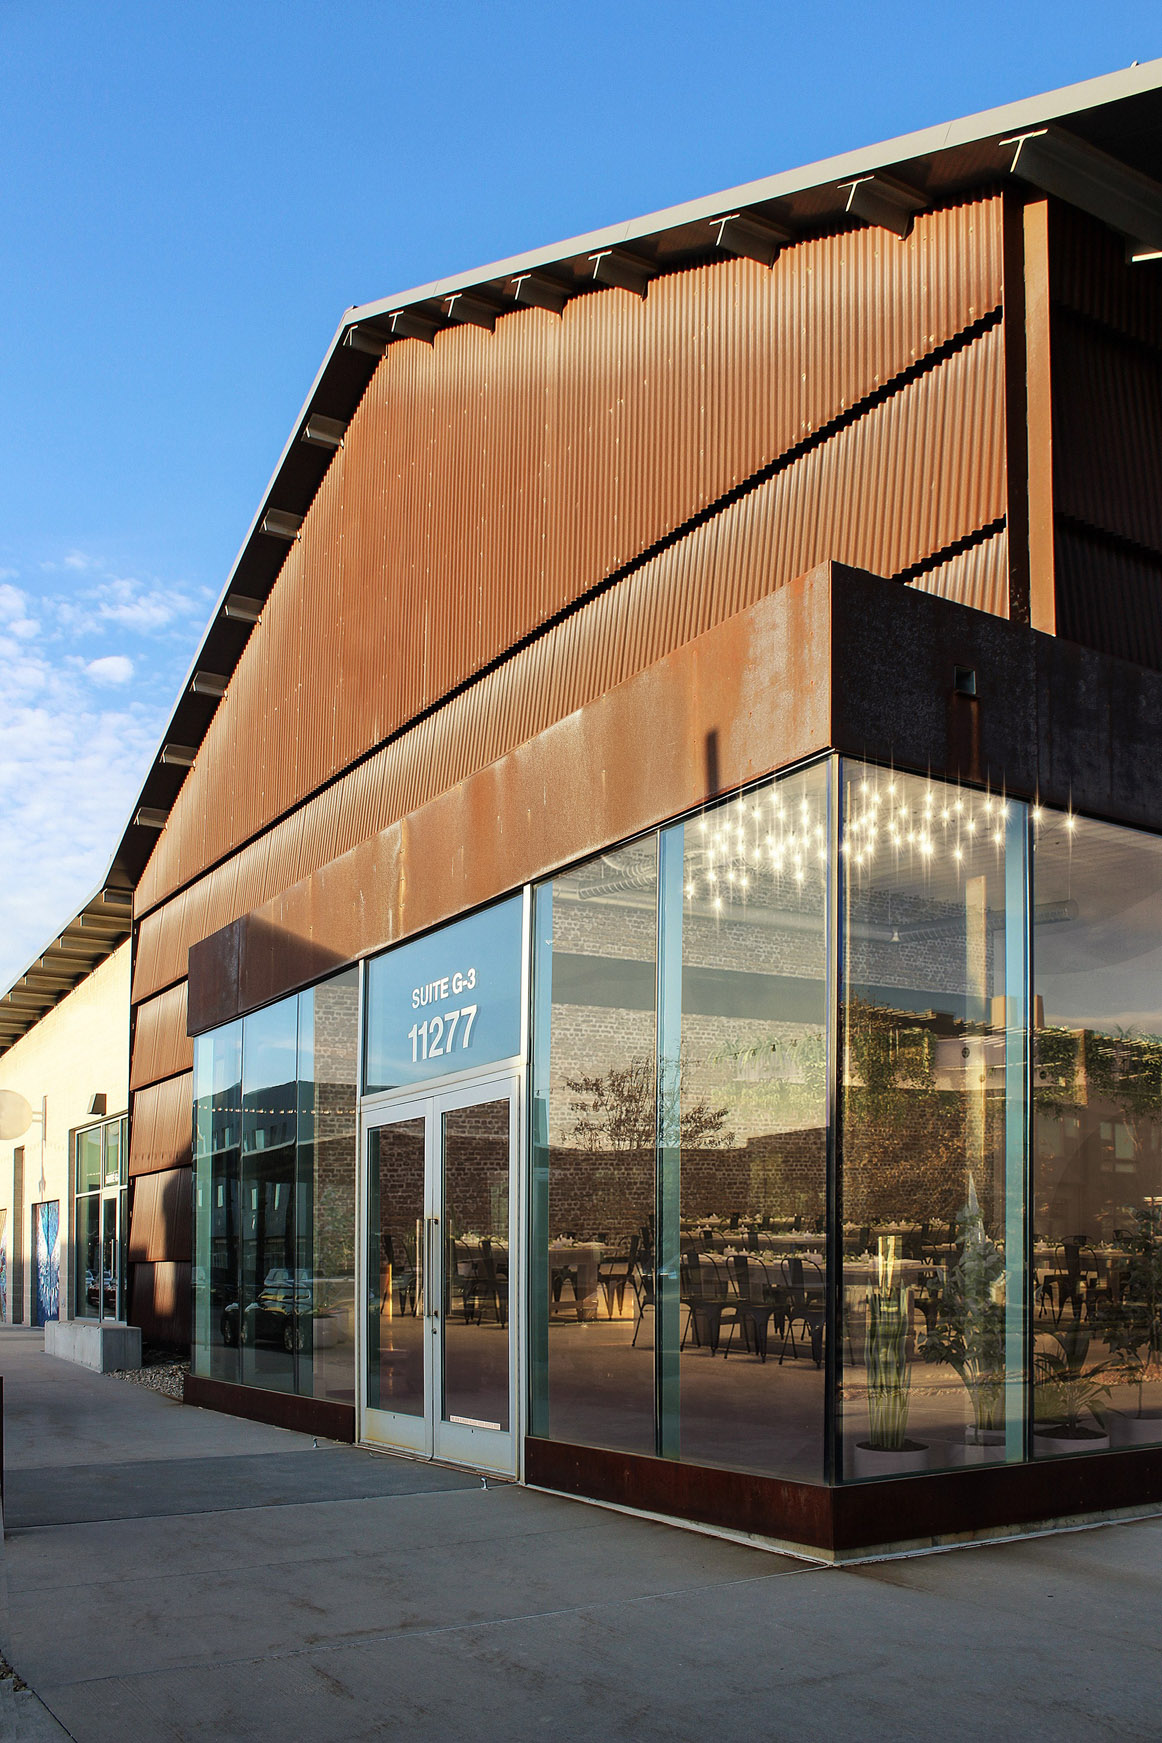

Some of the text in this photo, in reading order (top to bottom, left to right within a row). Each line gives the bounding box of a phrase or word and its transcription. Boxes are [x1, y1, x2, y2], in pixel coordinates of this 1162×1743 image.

[411, 967, 477, 1009] SUITE G-3
[407, 1004, 478, 1063] 11277
